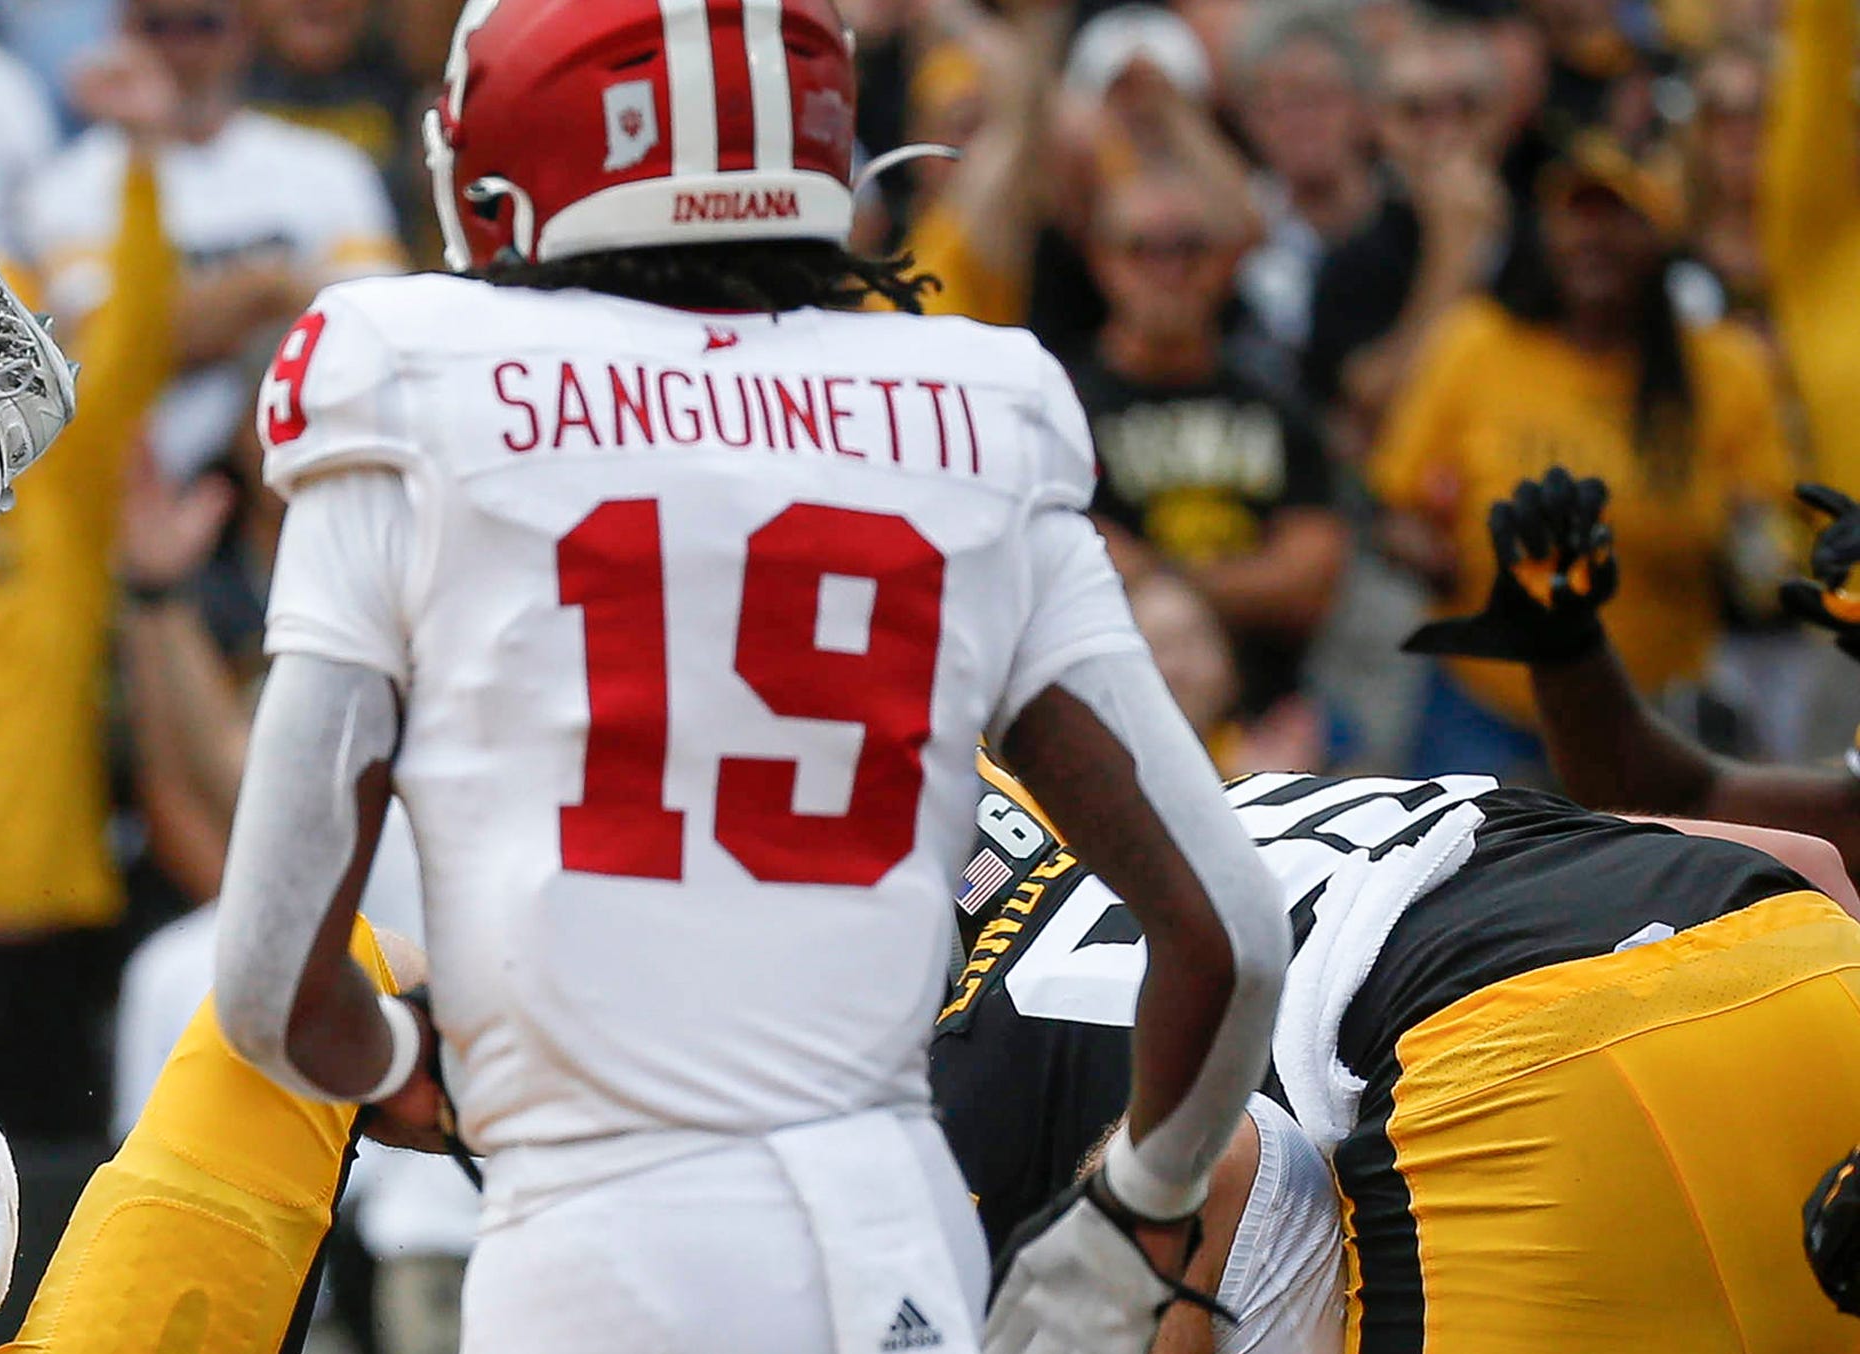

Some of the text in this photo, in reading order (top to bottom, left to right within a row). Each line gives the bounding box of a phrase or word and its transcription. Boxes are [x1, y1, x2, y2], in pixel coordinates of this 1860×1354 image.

[674, 188, 800, 223] INDIANA
[494, 361, 979, 475] SANGUINETTI
[555, 498, 947, 887] 19
